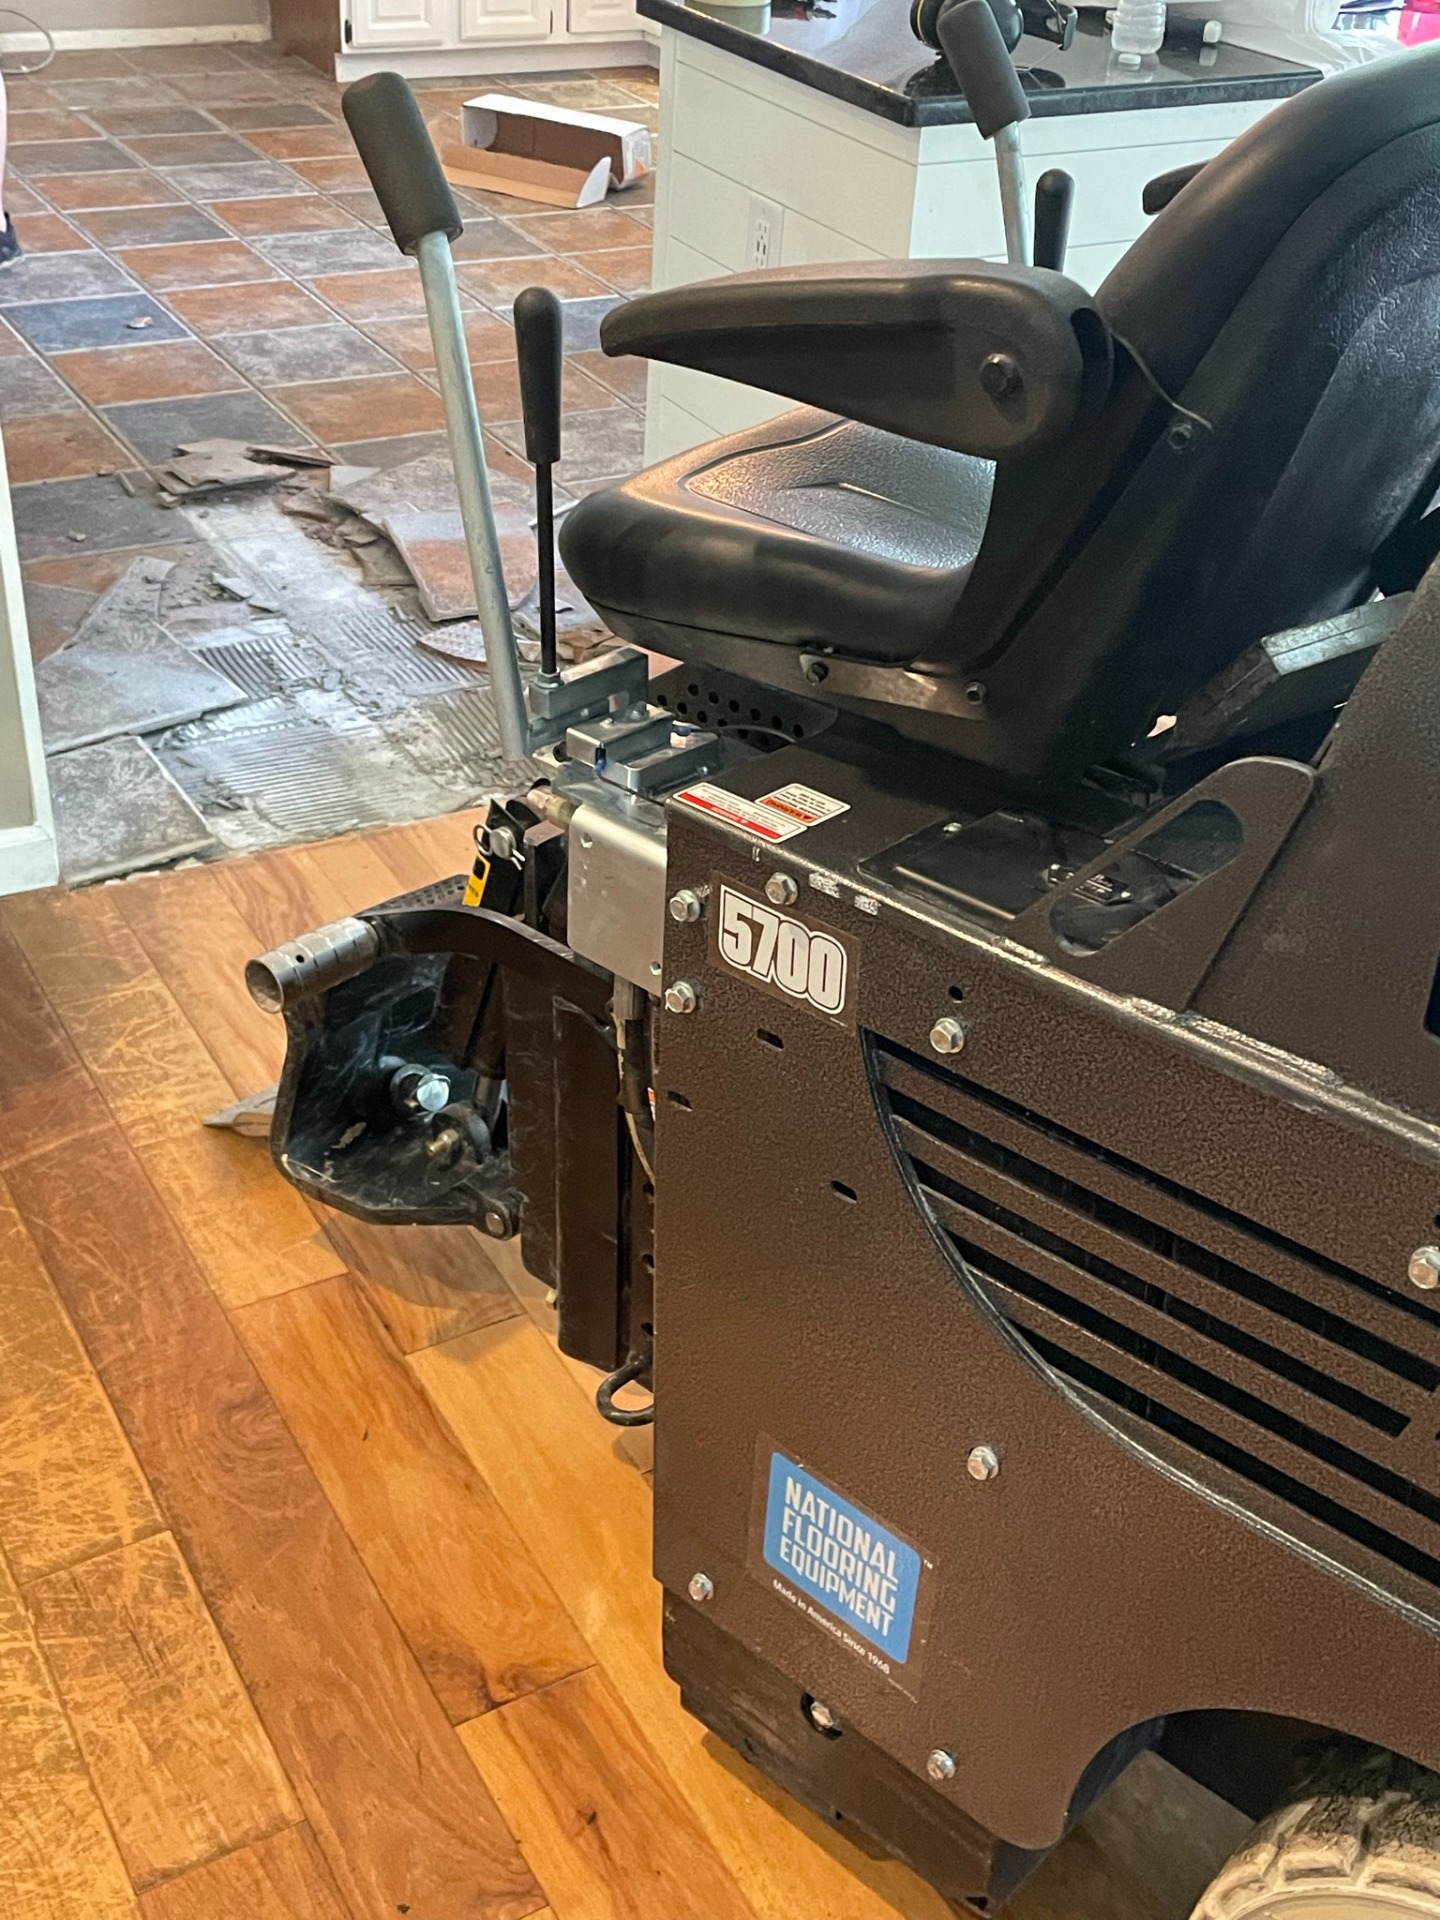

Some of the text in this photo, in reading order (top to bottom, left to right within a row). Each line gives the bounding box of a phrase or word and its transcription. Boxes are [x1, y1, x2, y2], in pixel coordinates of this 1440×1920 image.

[720, 886, 846, 1012] 5700
[782, 1506, 898, 1614] FLOORING
[784, 1476, 899, 1585] NATIONAL
[773, 1579, 797, 1604] Made
[807, 1606, 842, 1638] America
[842, 1632, 866, 1656] Since
[779, 1535, 894, 1637] EQUIPMENT
